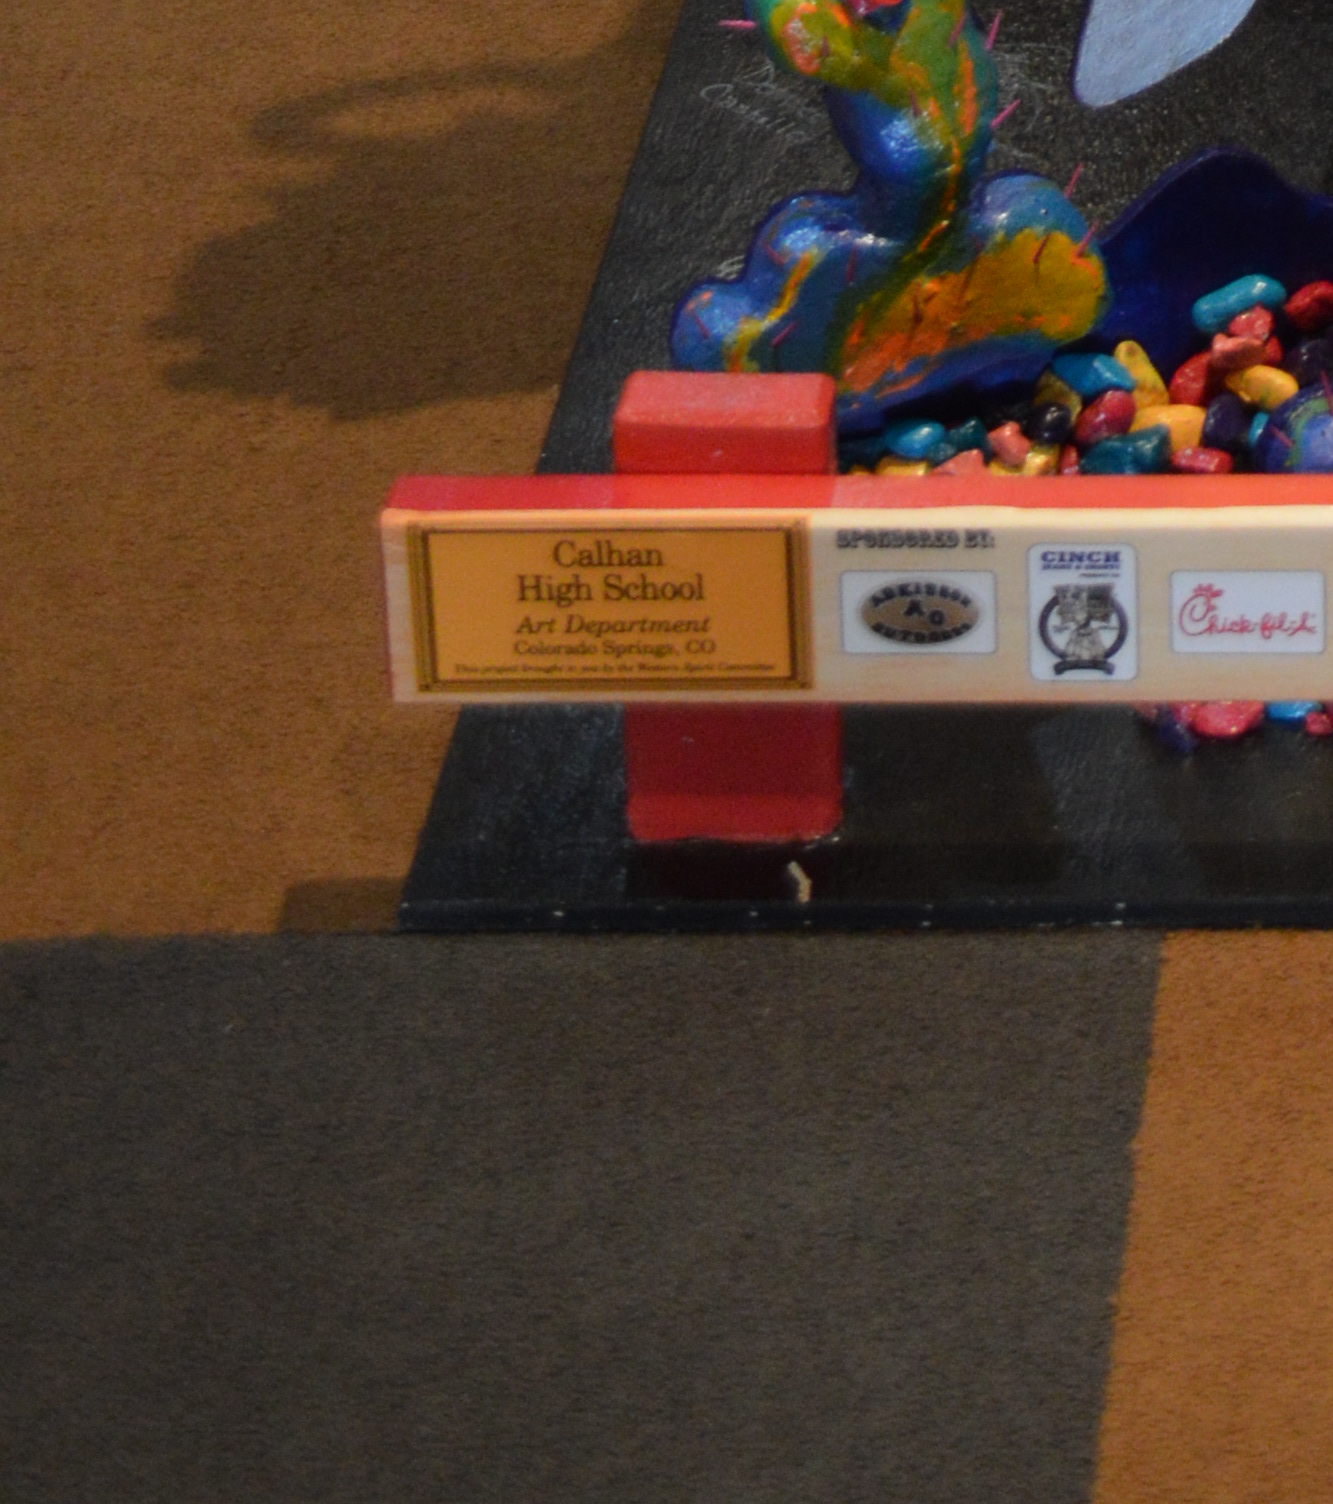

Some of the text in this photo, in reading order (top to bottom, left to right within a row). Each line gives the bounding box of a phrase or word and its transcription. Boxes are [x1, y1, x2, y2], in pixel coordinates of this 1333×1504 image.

[836, 529, 996, 549] SPONSORED BY:
[553, 539, 664, 568] Calhan
[1041, 550, 1121, 564] CINCH
[517, 573, 705, 608] High School
[515, 614, 711, 638] Art Department
[513, 641, 717, 659] Colorado Springs, CO
